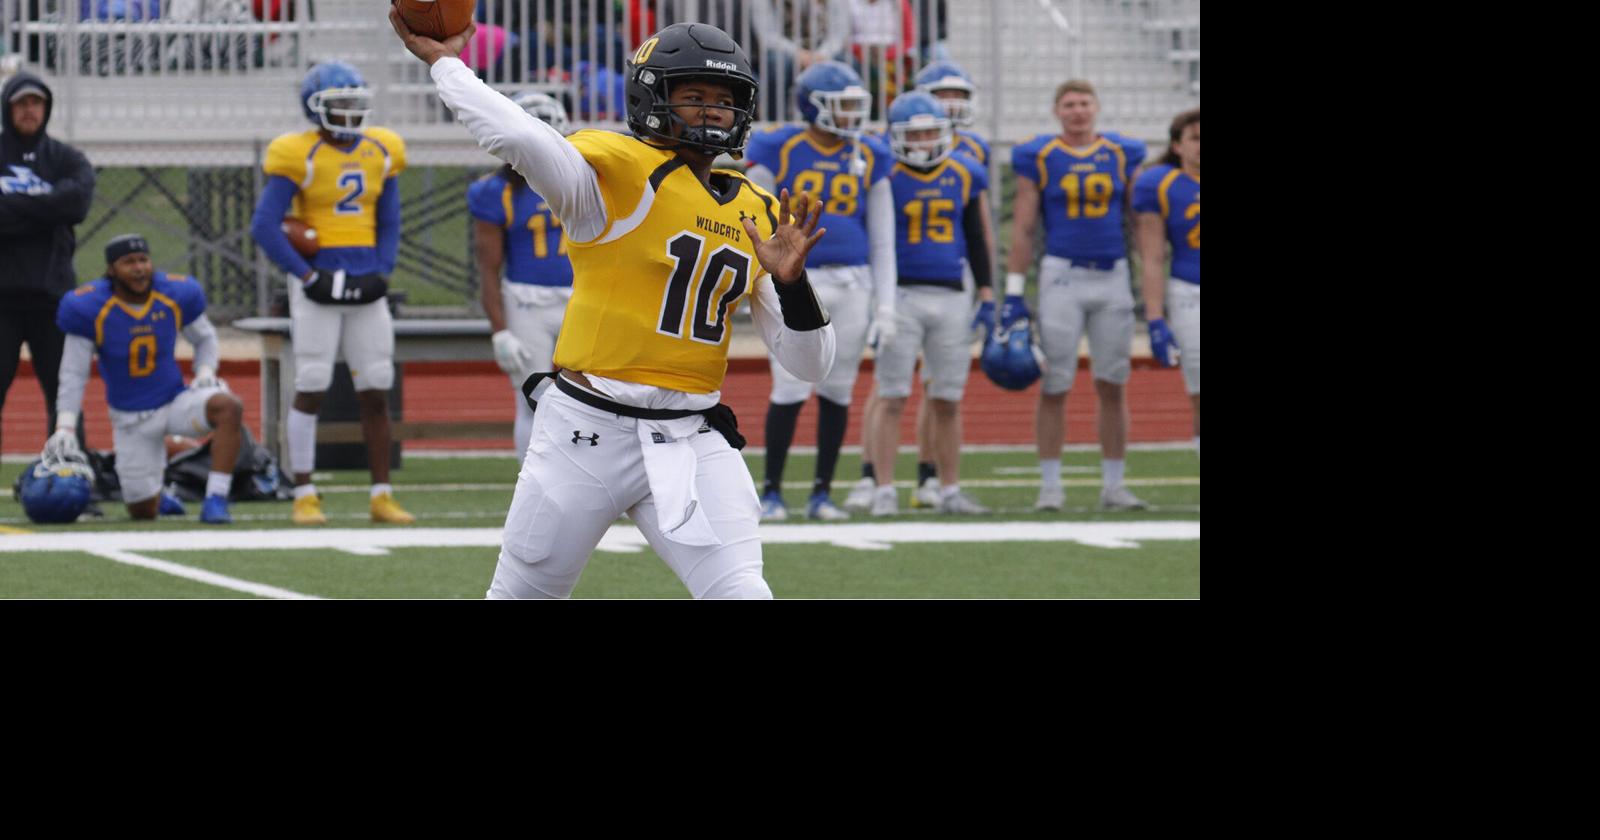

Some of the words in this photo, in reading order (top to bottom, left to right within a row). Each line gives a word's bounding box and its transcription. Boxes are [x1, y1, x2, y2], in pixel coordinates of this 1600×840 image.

[706, 60, 736, 71] Riddell
[334, 170, 366, 215] 2
[789, 170, 858, 215] 88
[1060, 173, 1113, 219] 19
[696, 215, 741, 242] WILDCATS
[904, 199, 954, 243] 15
[656, 229, 752, 346] 10
[130, 335, 156, 377] 0
